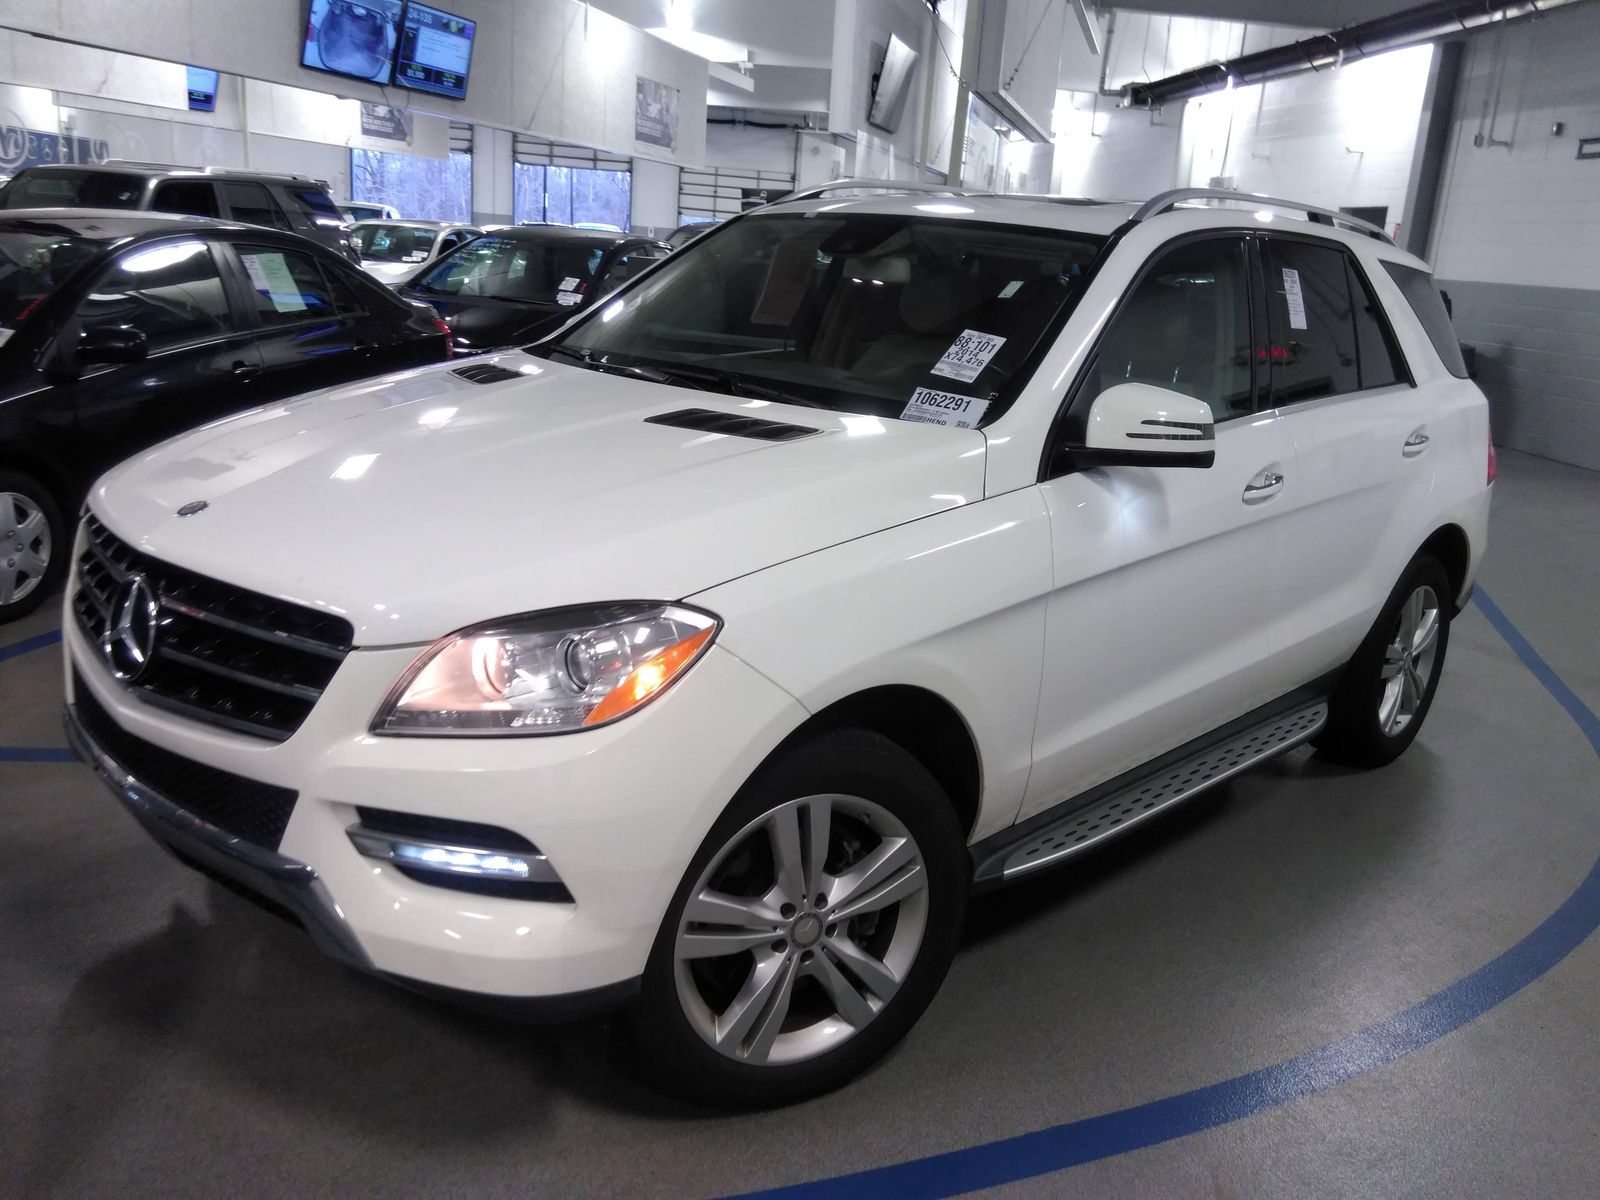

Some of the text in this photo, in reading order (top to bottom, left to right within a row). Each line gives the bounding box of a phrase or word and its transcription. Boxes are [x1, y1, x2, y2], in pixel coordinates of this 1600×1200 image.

[954, 335, 997, 354] 88:101
[955, 347, 980, 358] 2014
[914, 391, 972, 413] 1062291
[926, 417, 947, 426] HEND
